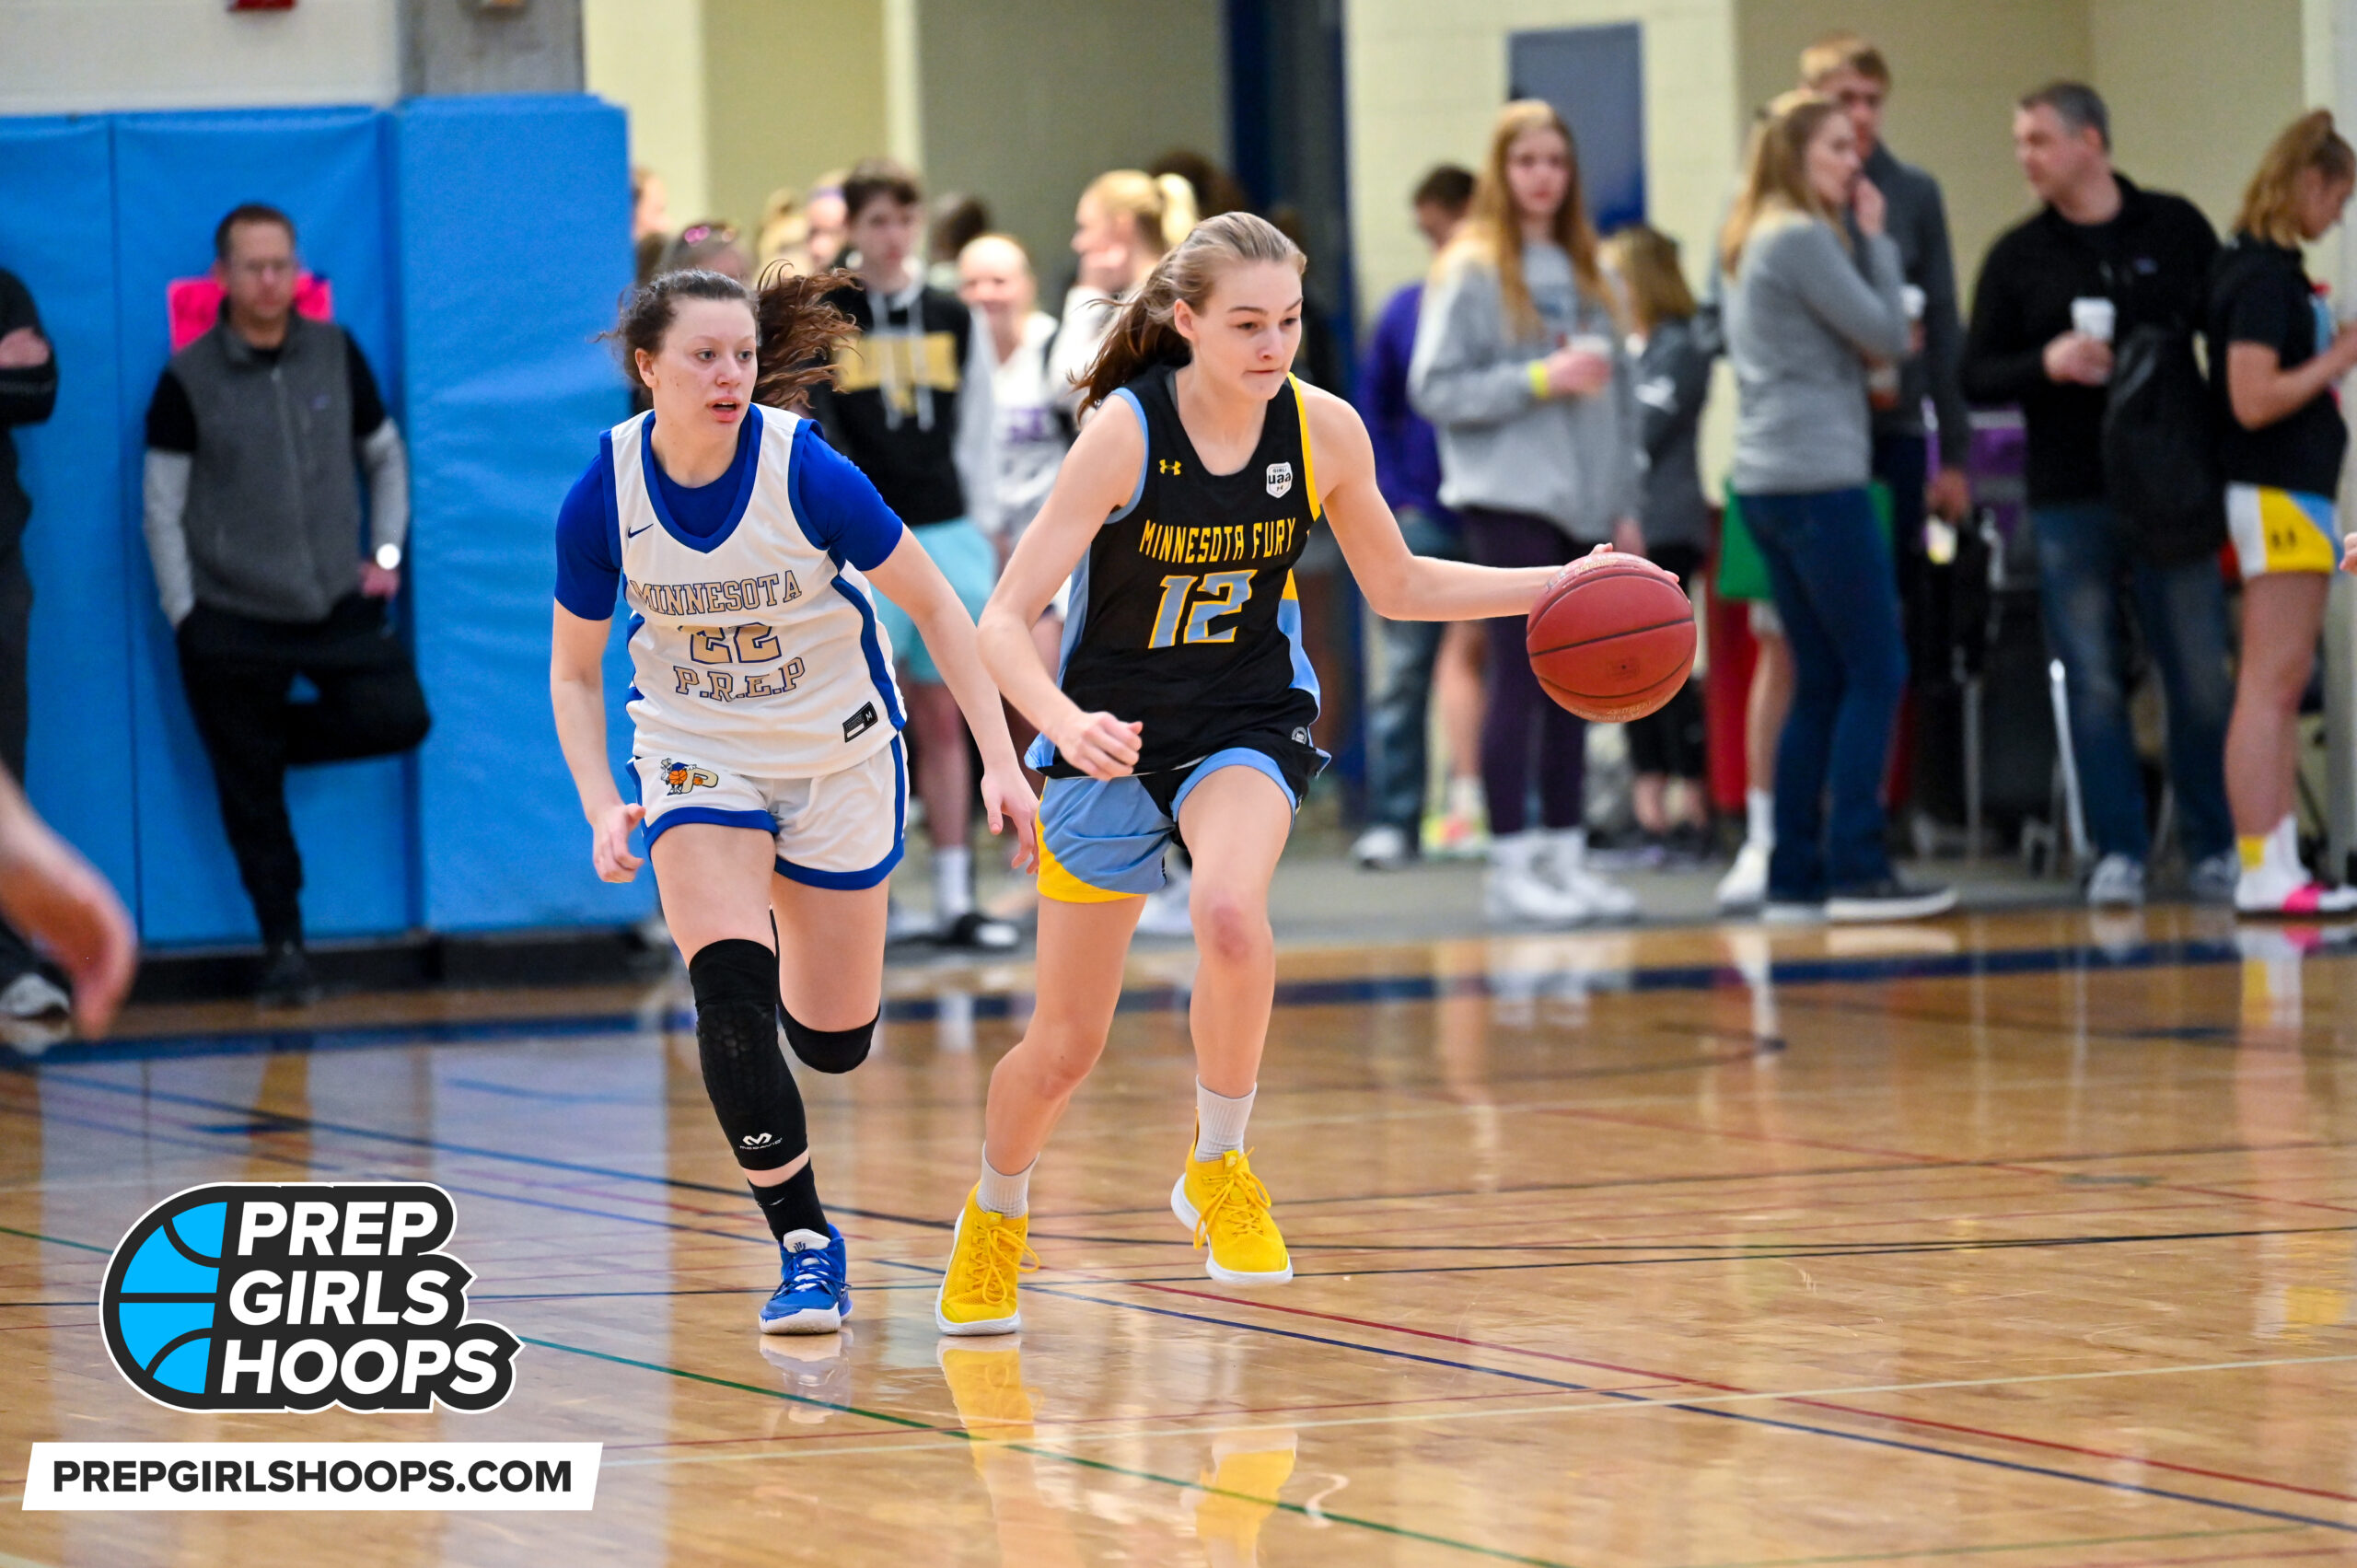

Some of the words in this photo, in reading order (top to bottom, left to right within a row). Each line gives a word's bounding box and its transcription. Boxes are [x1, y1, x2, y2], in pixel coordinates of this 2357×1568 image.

[1268, 472, 1292, 485] uaa
[1139, 518, 1244, 563] MINNESOTA
[1251, 517, 1296, 559] FURY
[629, 570, 802, 616] MINNESOTA
[1147, 569, 1259, 649] 12
[672, 656, 806, 703] P.R.E.P
[865, 711, 873, 722] M
